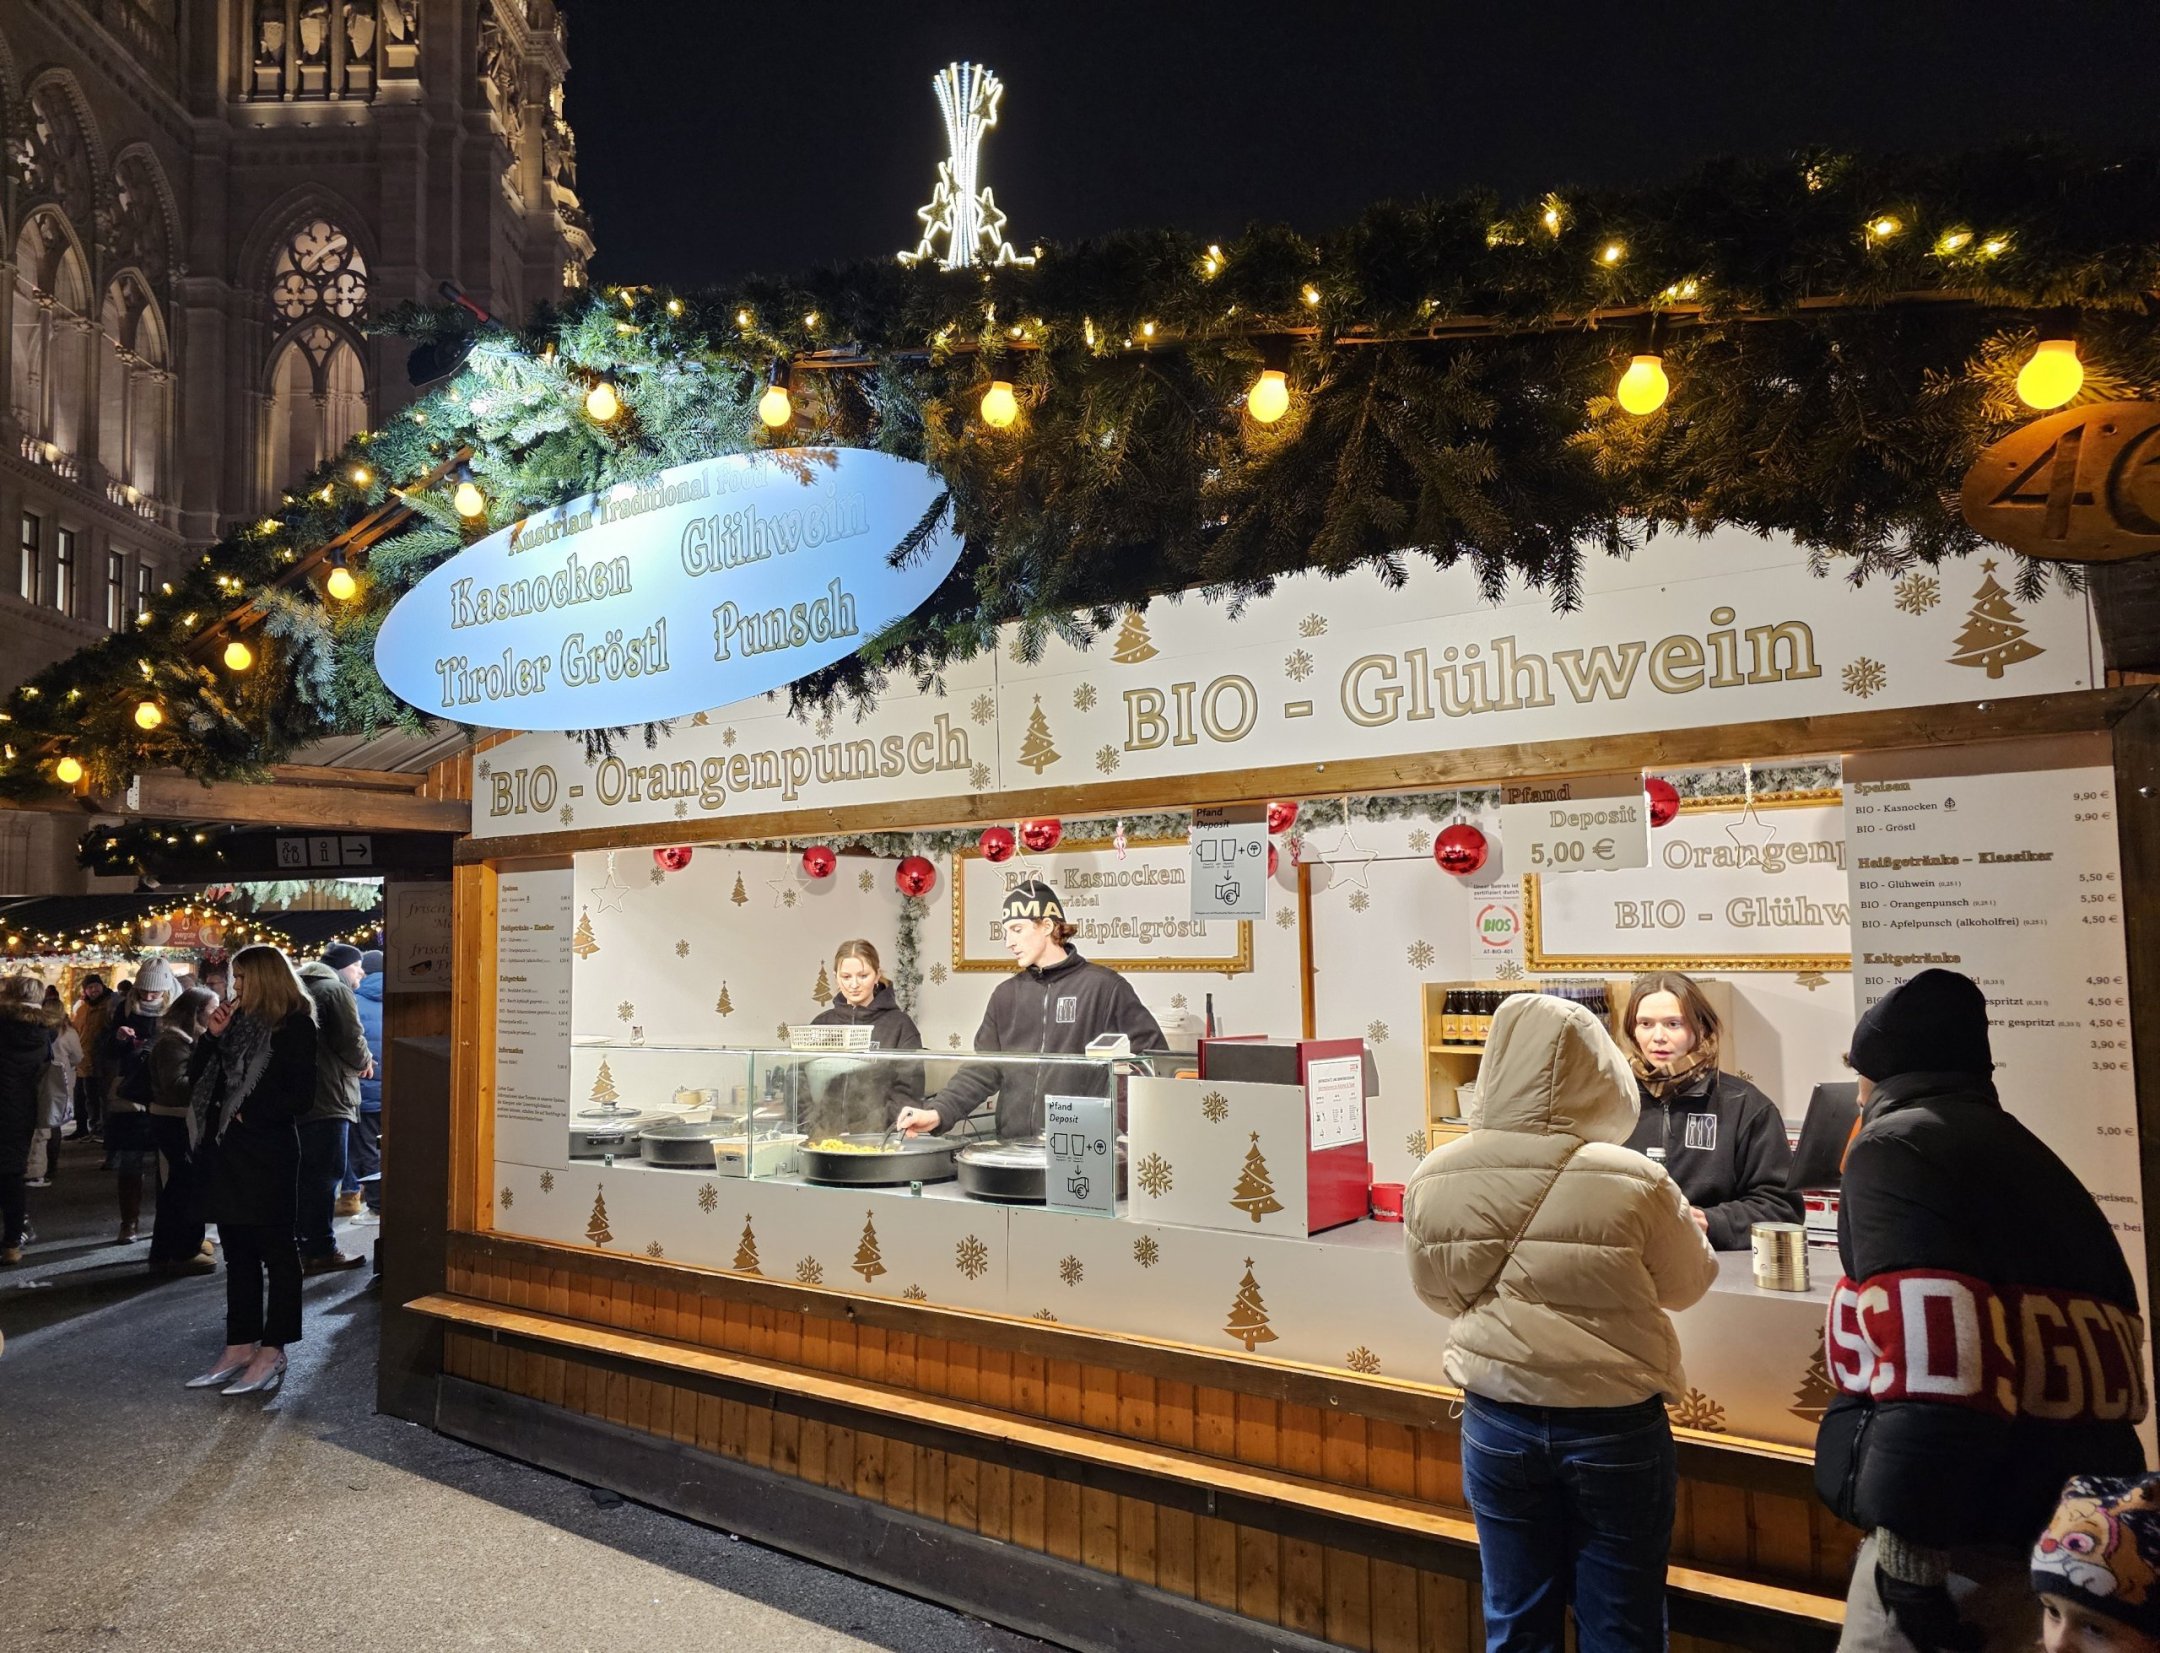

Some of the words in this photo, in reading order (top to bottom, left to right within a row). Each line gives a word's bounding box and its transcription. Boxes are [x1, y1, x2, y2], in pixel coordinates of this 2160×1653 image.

[508, 508, 593, 556] Austrian
[598, 467, 709, 525] Traditional
[717, 463, 768, 495] Food
[681, 480, 870, 577] Glühwein
[451, 552, 632, 629] Kasnocken
[713, 577, 859, 661] Punsch
[435, 647, 551, 707] Tiroler
[561, 617, 669, 687] Gröstl
[1122, 674, 1258, 751] BIO
[1341, 606, 1822, 727] Glühwein
[490, 764, 558, 817] BIO
[596, 713, 972, 811] Orangenpunsch
[1507, 784, 1571, 804] Pfand
[1854, 781, 1911, 796] Speisen
[2073, 792, 2097, 801] 9,90
[2100, 790, 2110, 799] €
[1196, 807, 1223, 817] Pfand
[1856, 806, 1874, 814] BIO
[1884, 803, 1938, 813] Kasnocken
[1550, 805, 1637, 830] Deposit
[2074, 813, 2098, 821] 9,90
[2101, 812, 2111, 820] €
[1196, 820, 1230, 831] Deposit
[1856, 825, 1875, 833] BIO
[1885, 823, 1916, 832] Gröstl
[1531, 841, 1585, 867] 5,00
[1592, 838, 1616, 860] €
[1978, 850, 2054, 865] Klassiker
[1064, 864, 1186, 889] Kasnocken
[2079, 873, 2103, 882] 5,50
[2106, 872, 2115, 880] €
[1859, 881, 1878, 889] BIO
[1888, 880, 1935, 889] Glühwein
[2080, 894, 2104, 903] 5,50
[2107, 893, 2117, 902] €
[1860, 901, 1879, 909] BIO
[1889, 899, 1969, 910] Orangenpunsch
[1614, 899, 1686, 929] BIO
[2082, 915, 2106, 924] 4,50
[2108, 915, 2119, 923] €
[1483, 919, 1512, 932] BIOS
[1862, 920, 1881, 929] BIO
[1890, 919, 1952, 930] Apfelpunsch
[1956, 917, 2019, 928] (alkoholfrei)
[1863, 952, 1961, 967] Kaltgetränke
[1864, 977, 1884, 985] BIO
[2086, 976, 2110, 986] 4,90
[2113, 976, 2124, 985] €
[2087, 998, 2111, 1007] 4,50
[2115, 998, 2125, 1006] €
[2008, 1019, 2056, 1029] gespritzt
[2089, 1019, 2113, 1028] 4,50
[2116, 1019, 2126, 1027] €
[2090, 1040, 2115, 1049] 3,90
[2117, 1040, 2128, 1049] €
[2092, 1062, 2117, 1071] 3,90
[2119, 1062, 2129, 1070] €
[1049, 1101, 1073, 1111] Pfand
[1049, 1113, 1079, 1124] Deposit
[2097, 1126, 2121, 1136] 5,00
[2124, 1127, 2135, 1136] €
[2123, 1222, 2142, 1232] bei
